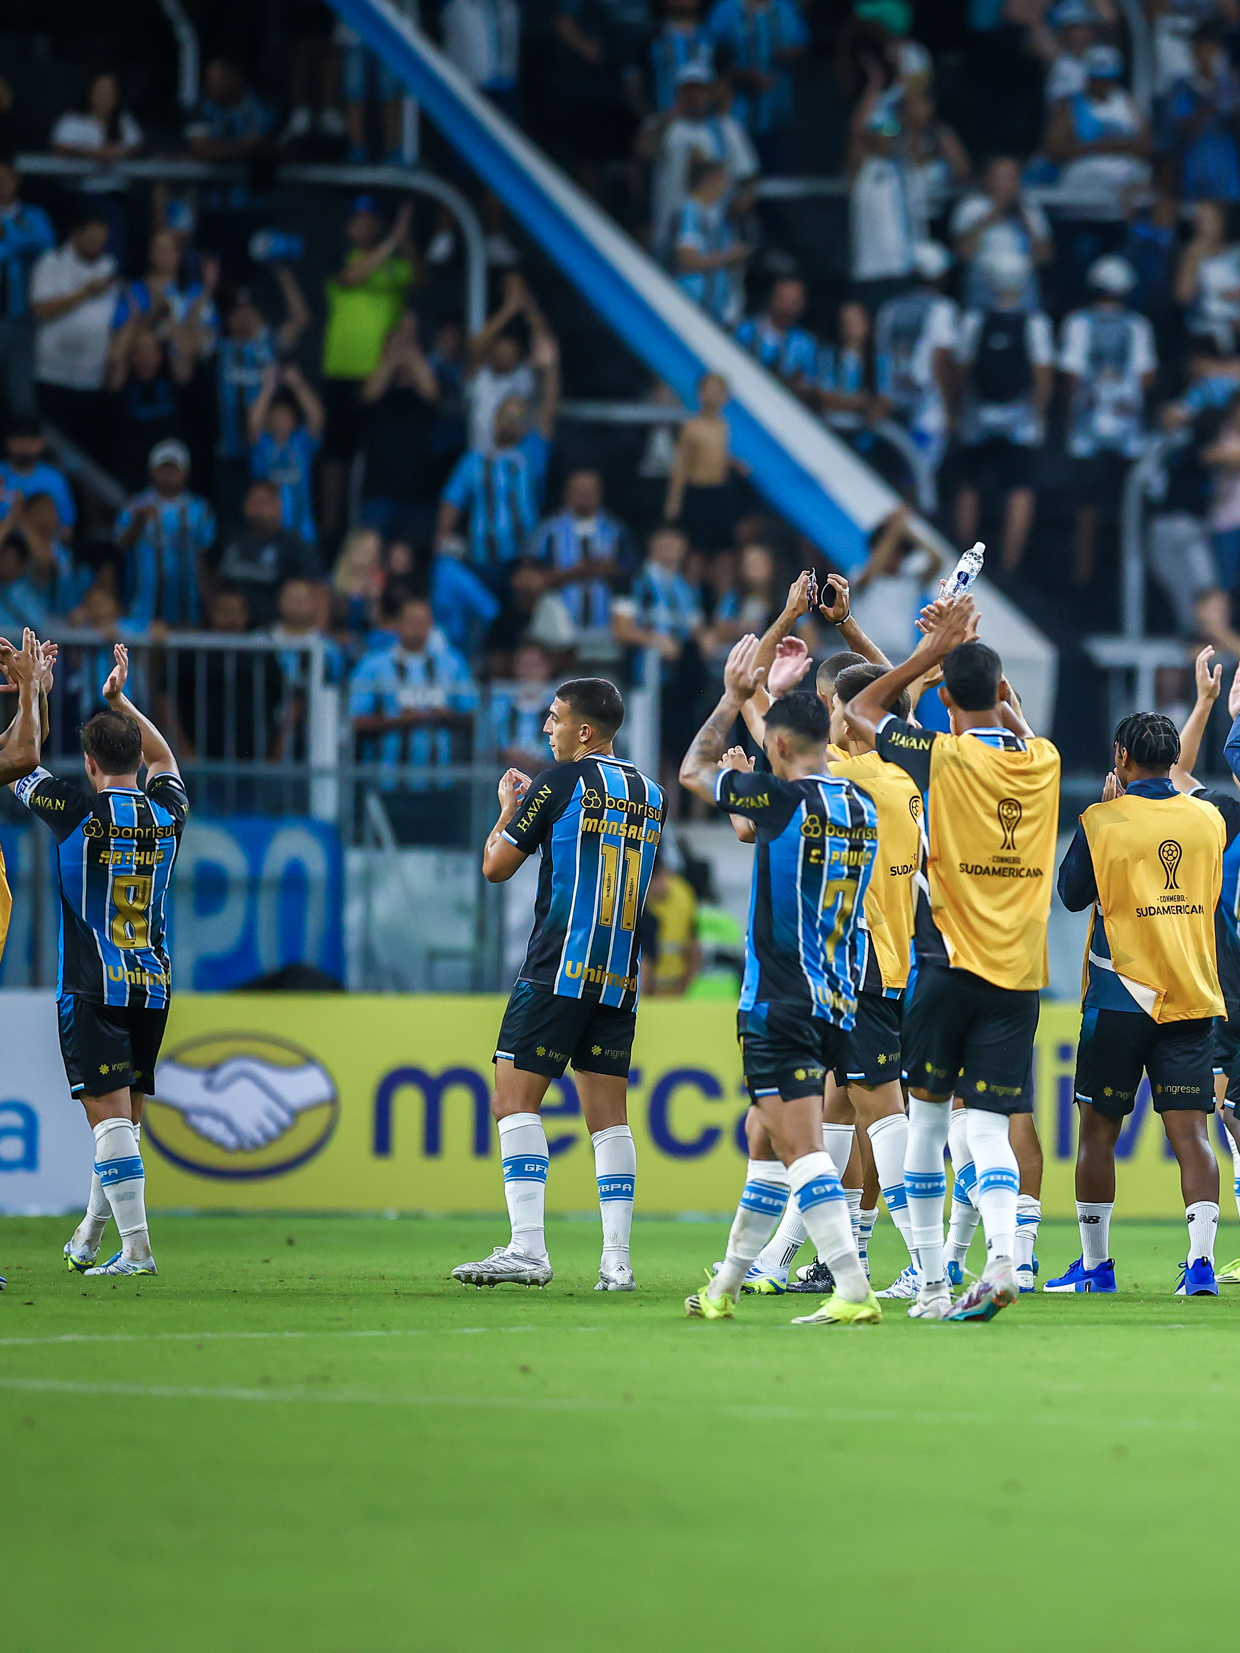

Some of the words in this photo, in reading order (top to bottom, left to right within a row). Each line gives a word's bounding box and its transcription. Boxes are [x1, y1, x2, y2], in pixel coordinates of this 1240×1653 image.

[30, 792, 67, 811] HAVAN
[517, 784, 553, 833] HAVAN
[111, 874, 152, 950] 8
[599, 842, 642, 933] 11
[823, 878, 858, 964] 7
[565, 961, 638, 992] Unimed
[1164, 1085, 1200, 1096] ingresse
